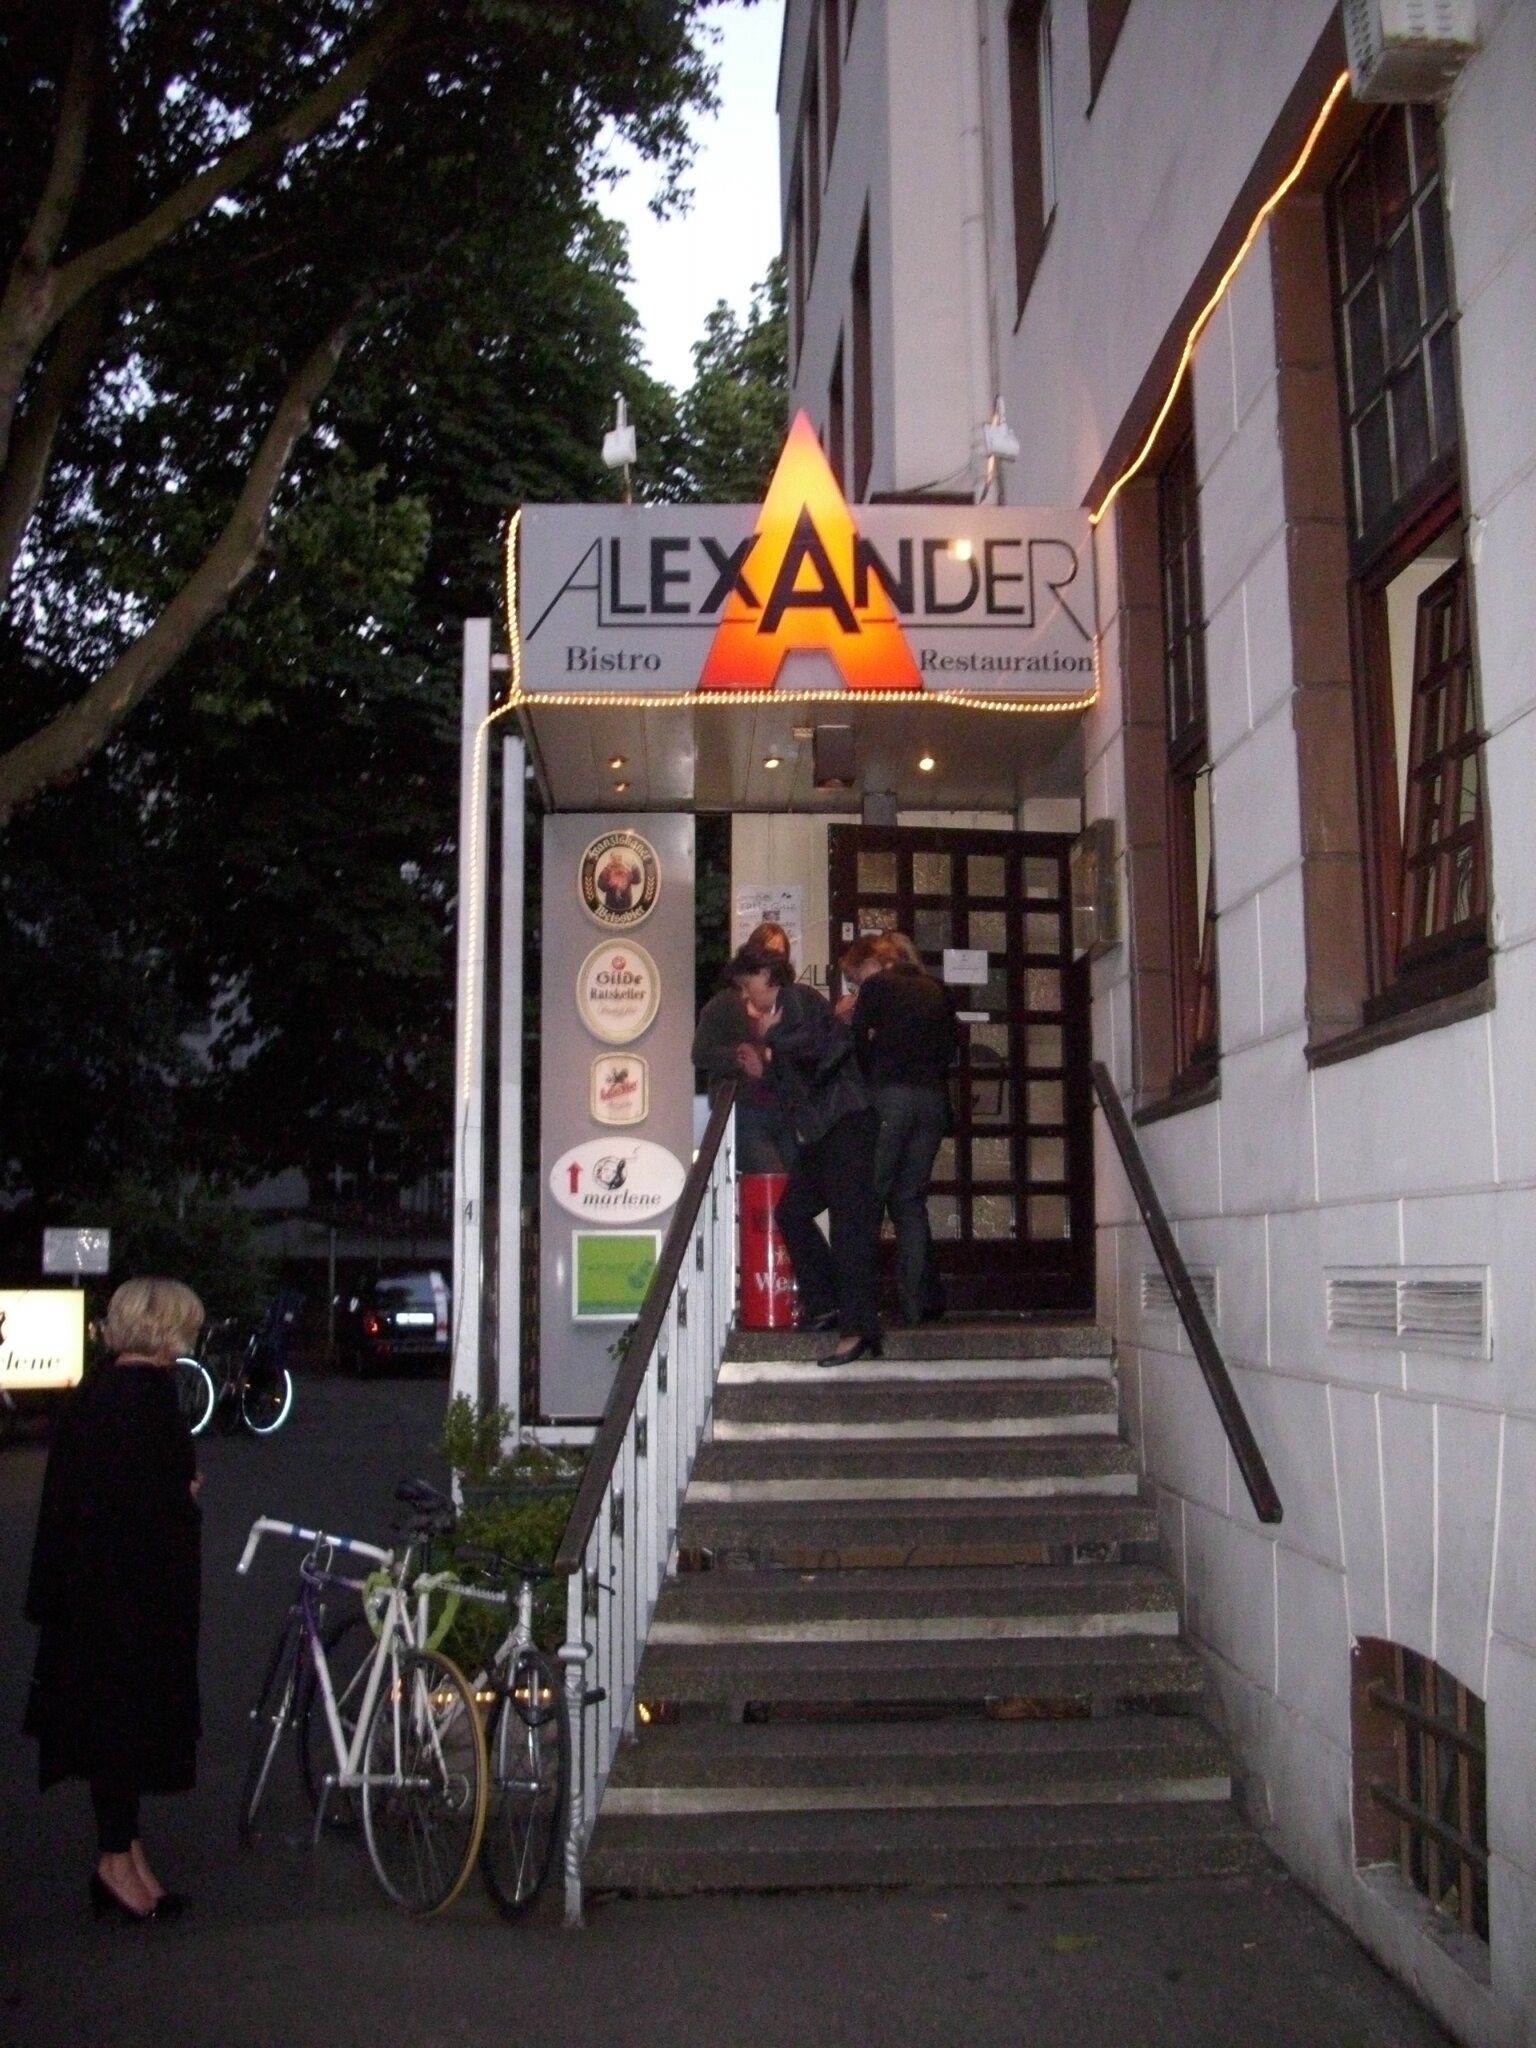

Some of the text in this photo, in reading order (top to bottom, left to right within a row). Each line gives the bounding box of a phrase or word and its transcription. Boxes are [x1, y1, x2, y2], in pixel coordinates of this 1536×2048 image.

[526, 501, 1092, 642] ALEXANDER
[566, 646, 662, 672] Bistro
[920, 649, 1094, 673] Restauration
[596, 970, 643, 985] Gilde
[583, 1190, 661, 1206] marlene
[1, 1350, 60, 1371] lene
